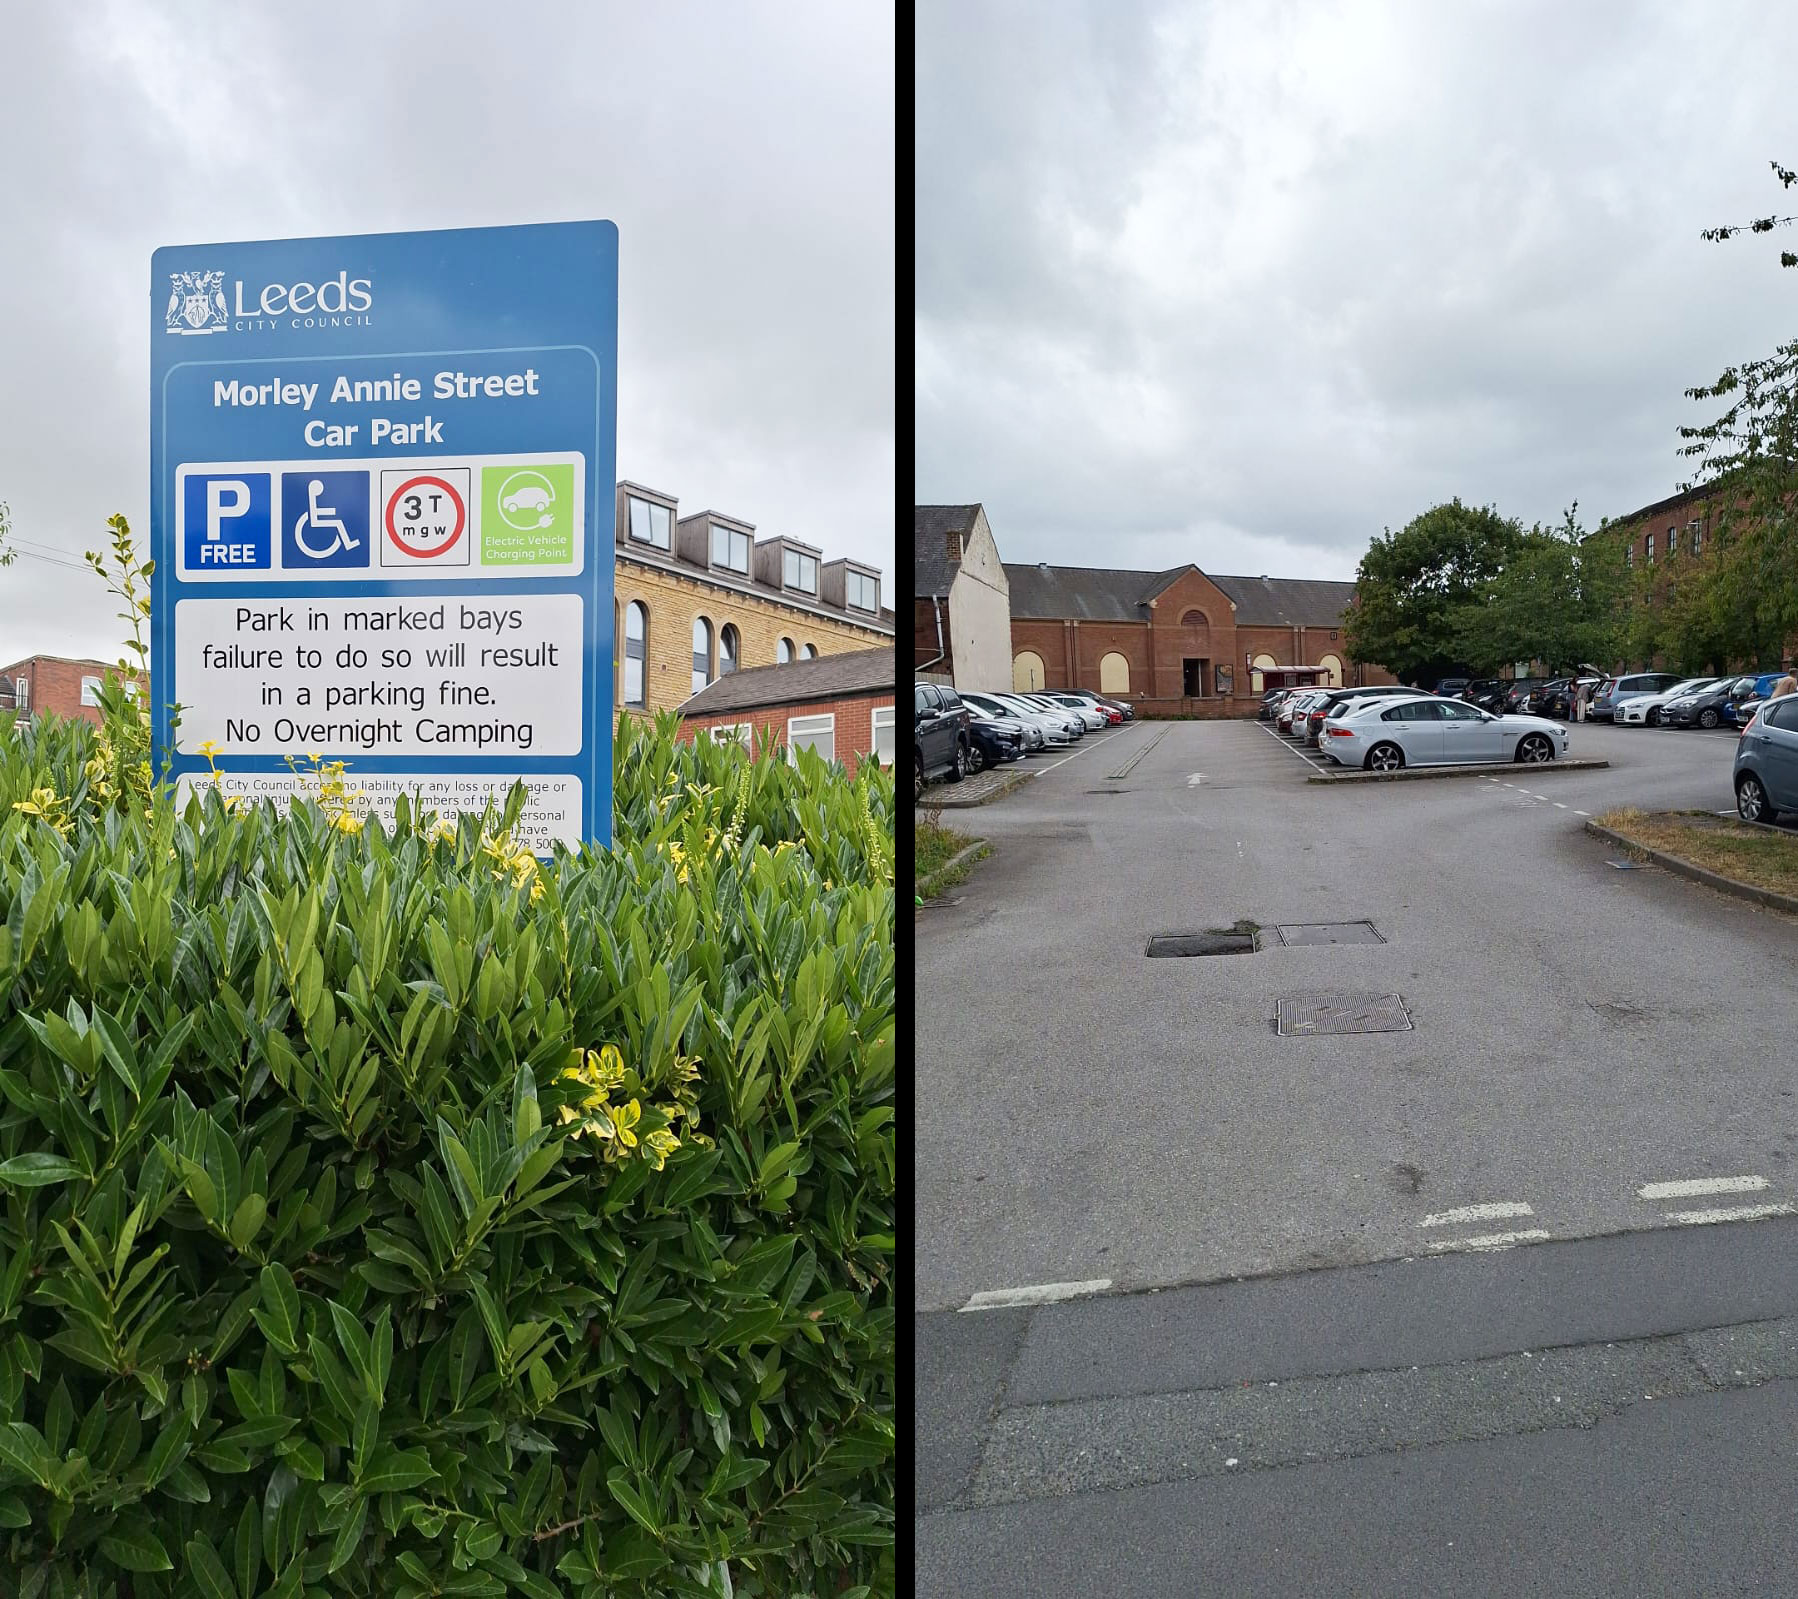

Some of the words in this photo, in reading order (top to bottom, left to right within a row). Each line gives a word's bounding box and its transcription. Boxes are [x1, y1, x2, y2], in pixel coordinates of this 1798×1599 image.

[235, 270, 372, 316] Leeds
[235, 320, 277, 331] CITY
[291, 315, 372, 329] COUNCIL
[214, 377, 318, 410] Morley
[330, 372, 421, 402] Annie
[433, 368, 539, 400] Street
[304, 420, 358, 447] Car
[371, 416, 444, 446] Park
[207, 480, 251, 541] P
[485, 536, 525, 546] Electric
[528, 535, 567, 545] Vehicle
[200, 544, 256, 564] FREE
[486, 549, 535, 561] Charging
[538, 548, 567, 558] Point
[236, 607, 294, 632] Park
[308, 606, 329, 631] in
[344, 605, 445, 631] marked
[460, 605, 523, 635] bays
[203, 644, 283, 669] failure
[296, 647, 322, 669] to
[336, 644, 367, 669] do
[381, 649, 412, 668] so
[426, 643, 466, 667] will
[481, 642, 559, 667] result
[261, 682, 282, 706] in
[296, 687, 311, 706] a
[326, 681, 425, 711] parking
[439, 680, 496, 706] fine.
[226, 719, 260, 743] No
[274, 718, 402, 749] Overnight
[416, 718, 533, 749] Camping
[190, 779, 222, 790] eed
[226, 779, 248, 792] City
[253, 780, 296, 790] Council
[344, 782, 357, 790] no
[361, 780, 403, 792] liability
[408, 780, 424, 791] for
[429, 783, 451, 793] any
[455, 780, 479, 792] loss
[482, 783, 496, 791] or
[553, 783, 567, 792] or
[358, 793, 372, 806] by
[377, 795, 398, 807] any
[405, 795, 459, 806] mbers
[463, 794, 476, 806] of
[517, 809, 565, 820] ersonal
[512, 838, 530, 849] 78
